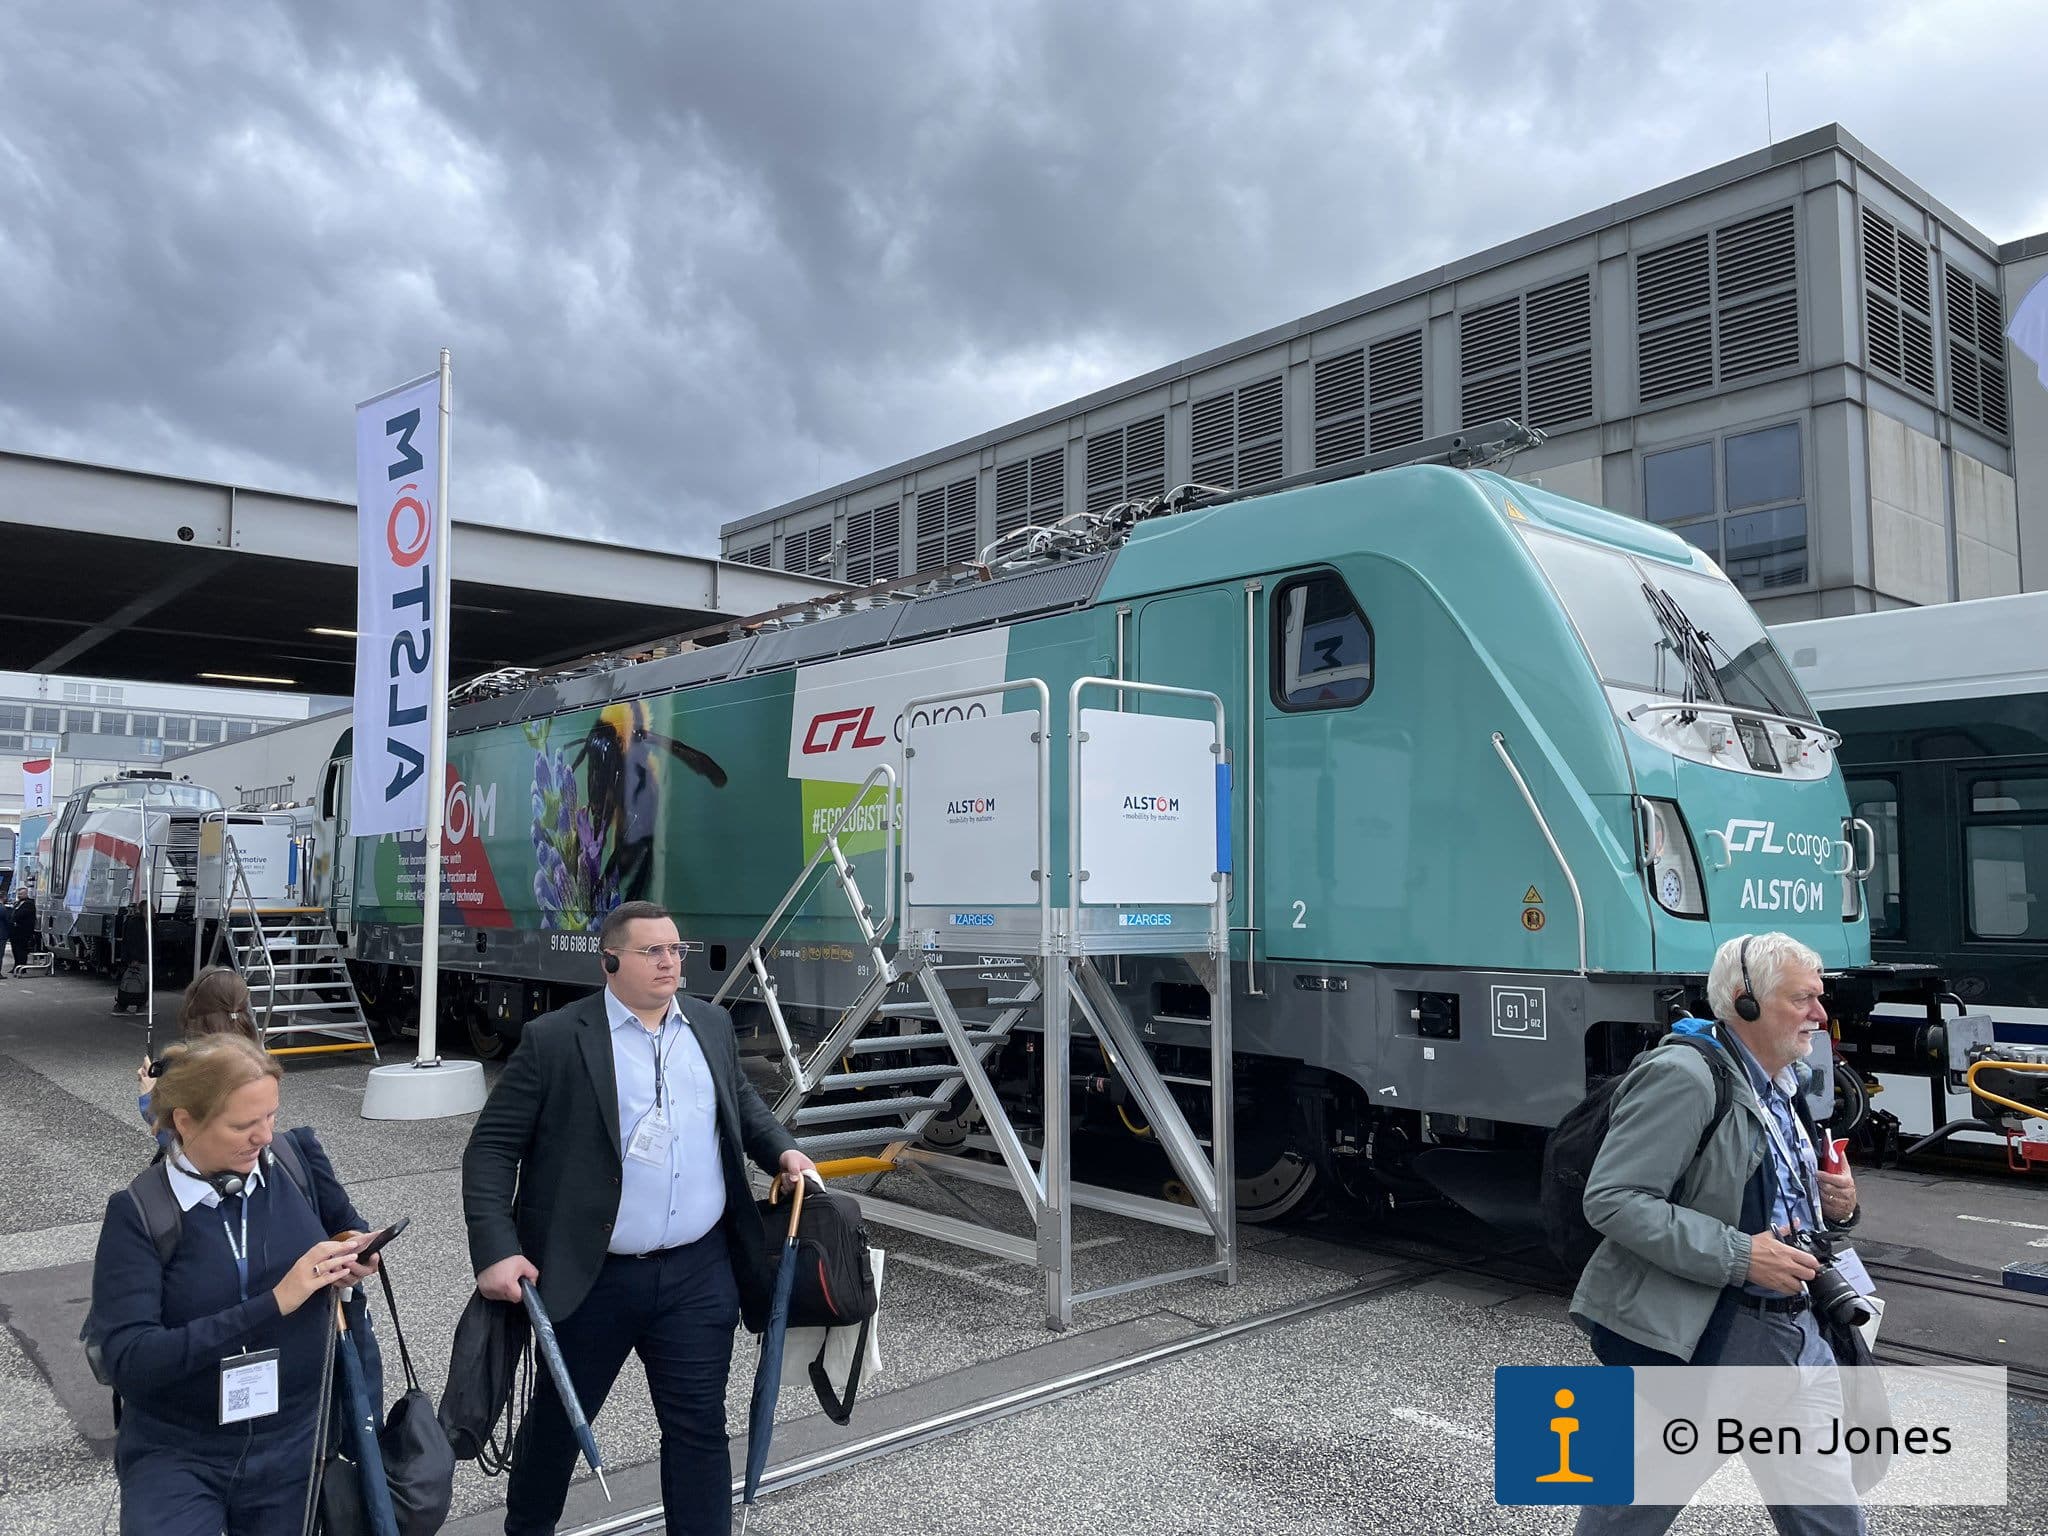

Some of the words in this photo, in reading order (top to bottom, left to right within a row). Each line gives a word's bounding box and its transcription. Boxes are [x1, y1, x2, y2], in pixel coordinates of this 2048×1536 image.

[802, 706, 886, 754] CFL
[947, 798, 994, 814] ALSTOM
[1124, 796, 1178, 812] ALSTOM
[1725, 819, 1784, 853] CFL
[1787, 832, 1830, 865] cargo
[447, 871, 466, 882] traction
[467, 870, 477, 882] and
[457, 889, 484, 904] technology
[1740, 878, 1823, 913] ALSTOM
[957, 914, 994, 926] ZARGES
[1128, 914, 1171, 925] ZARGES
[1292, 900, 1306, 928] 2
[551, 935, 559, 950] 91
[560, 935, 569, 951] 80
[570, 936, 587, 952] 6188
[1530, 999, 1537, 1007] G1
[1507, 1005, 1518, 1018] G1
